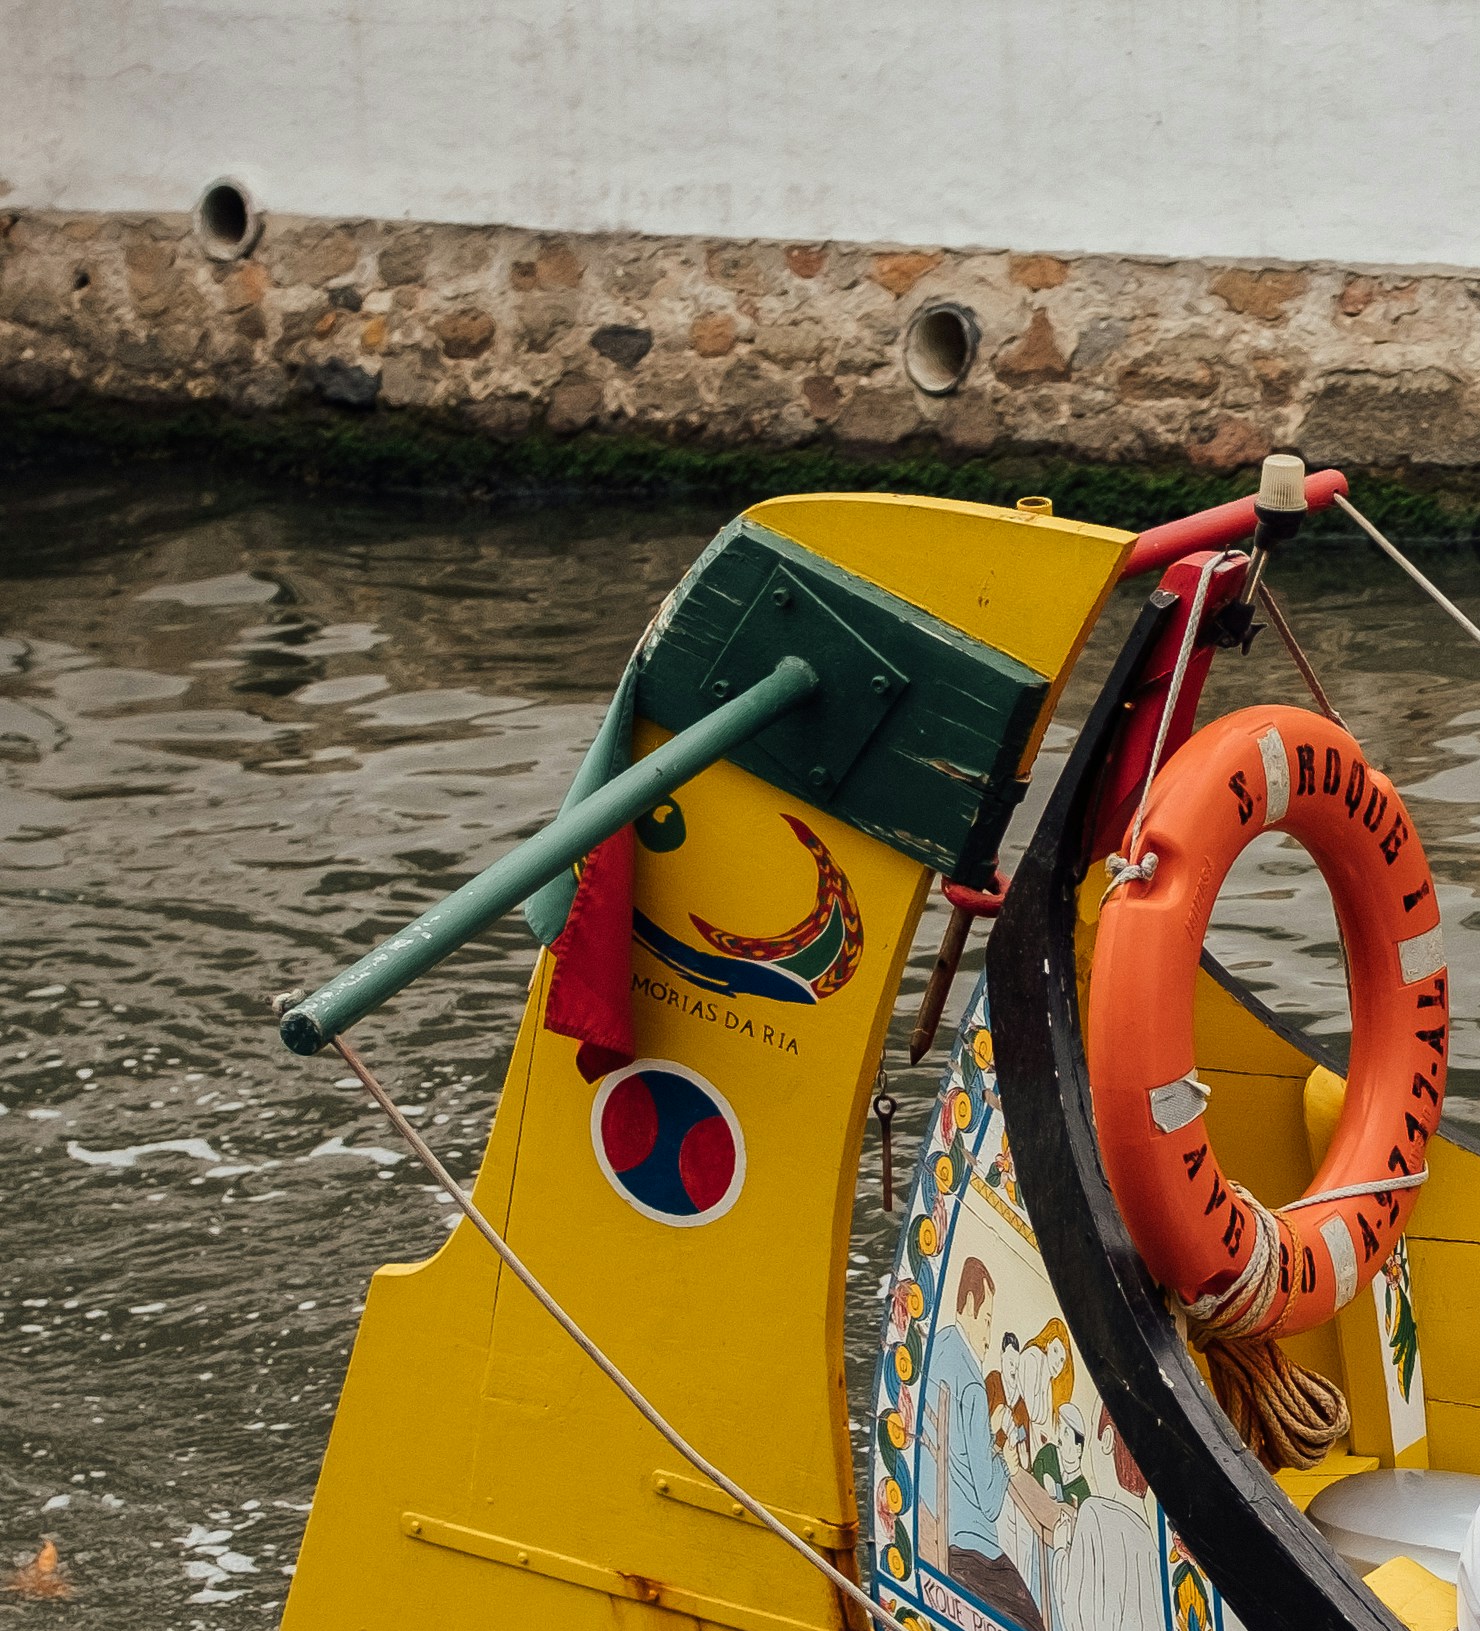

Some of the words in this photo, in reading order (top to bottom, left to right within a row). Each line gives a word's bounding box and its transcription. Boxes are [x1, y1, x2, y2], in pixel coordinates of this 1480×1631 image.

[1296, 743, 1409, 866] ROQUE
[631, 973, 717, 1022] MÓRIAS
[724, 1010, 755, 1037] DA
[762, 1024, 799, 1055] RIA
[1183, 1143, 1317, 1294] AVERO
